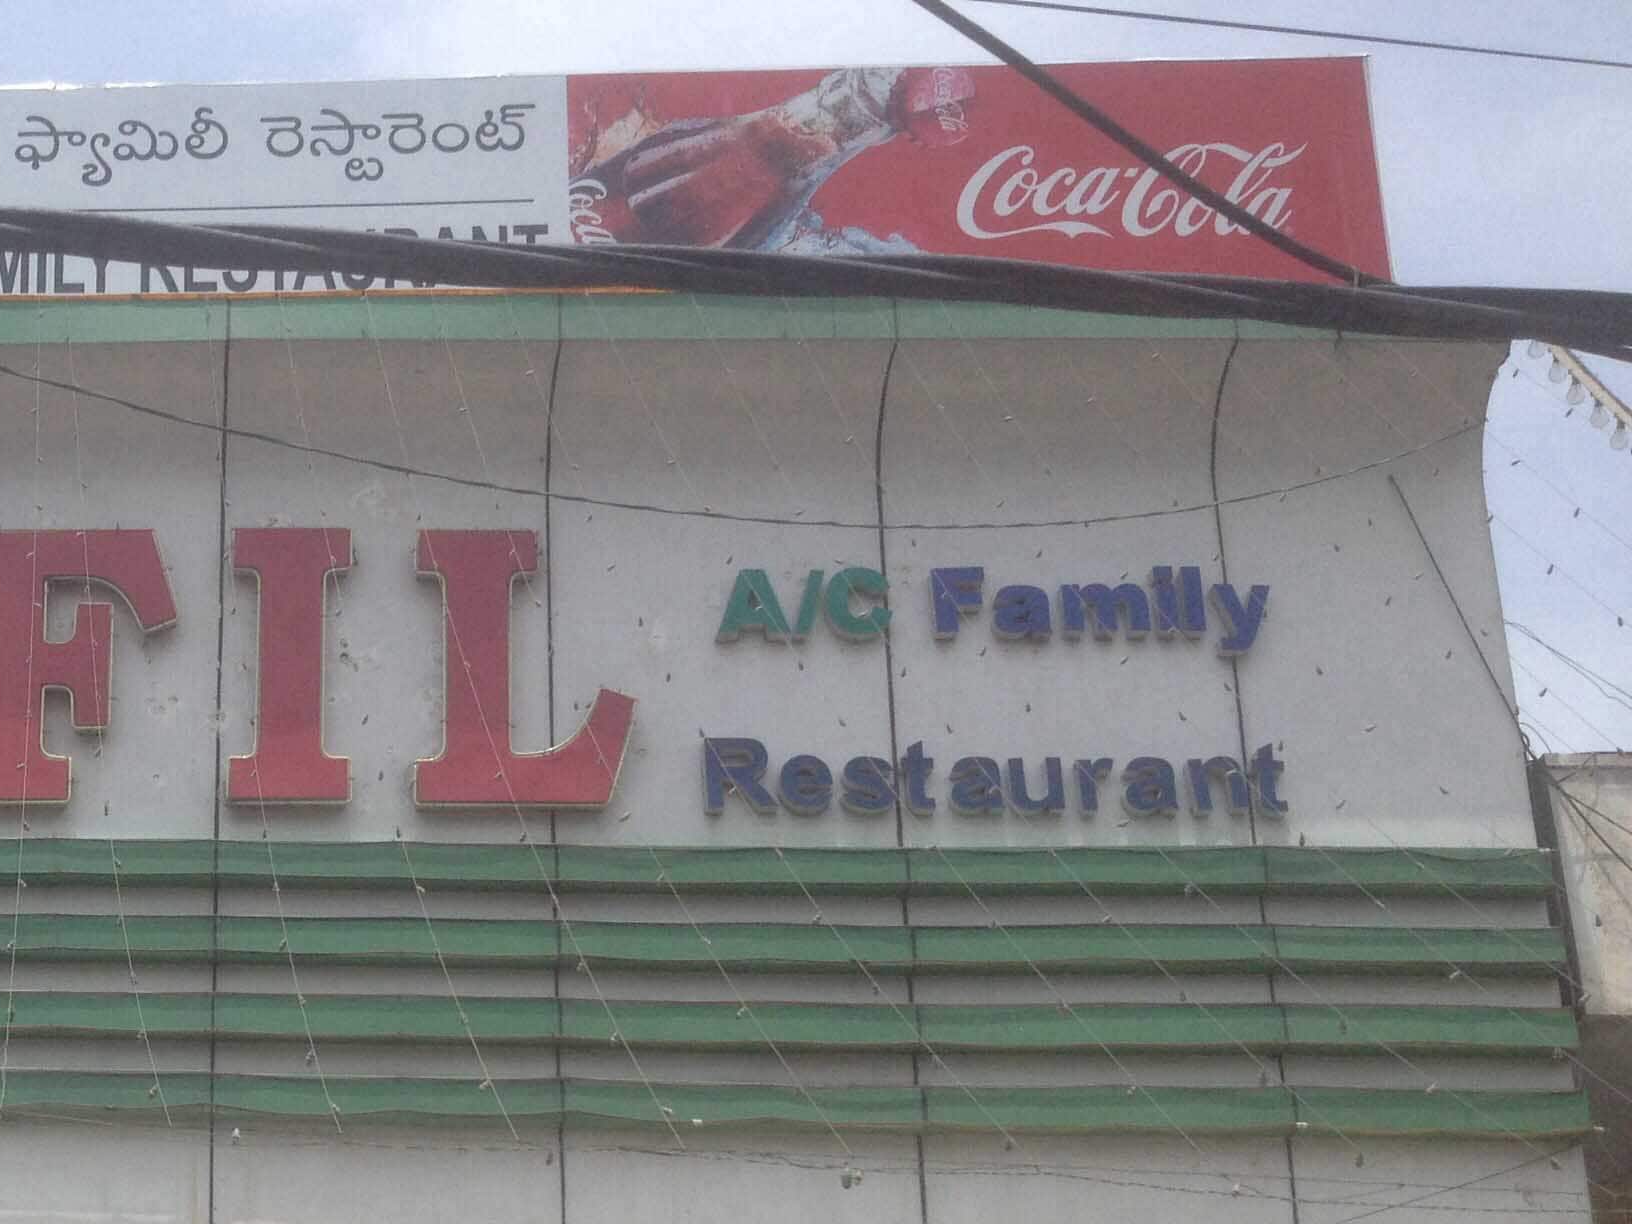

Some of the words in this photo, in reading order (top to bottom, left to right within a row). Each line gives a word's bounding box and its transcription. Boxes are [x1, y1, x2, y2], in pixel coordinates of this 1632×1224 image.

[956, 142, 1308, 240] Coca-Cola
[715, 567, 893, 643] A/C
[929, 565, 1270, 656] Family
[704, 736, 1290, 816] Restaurant
